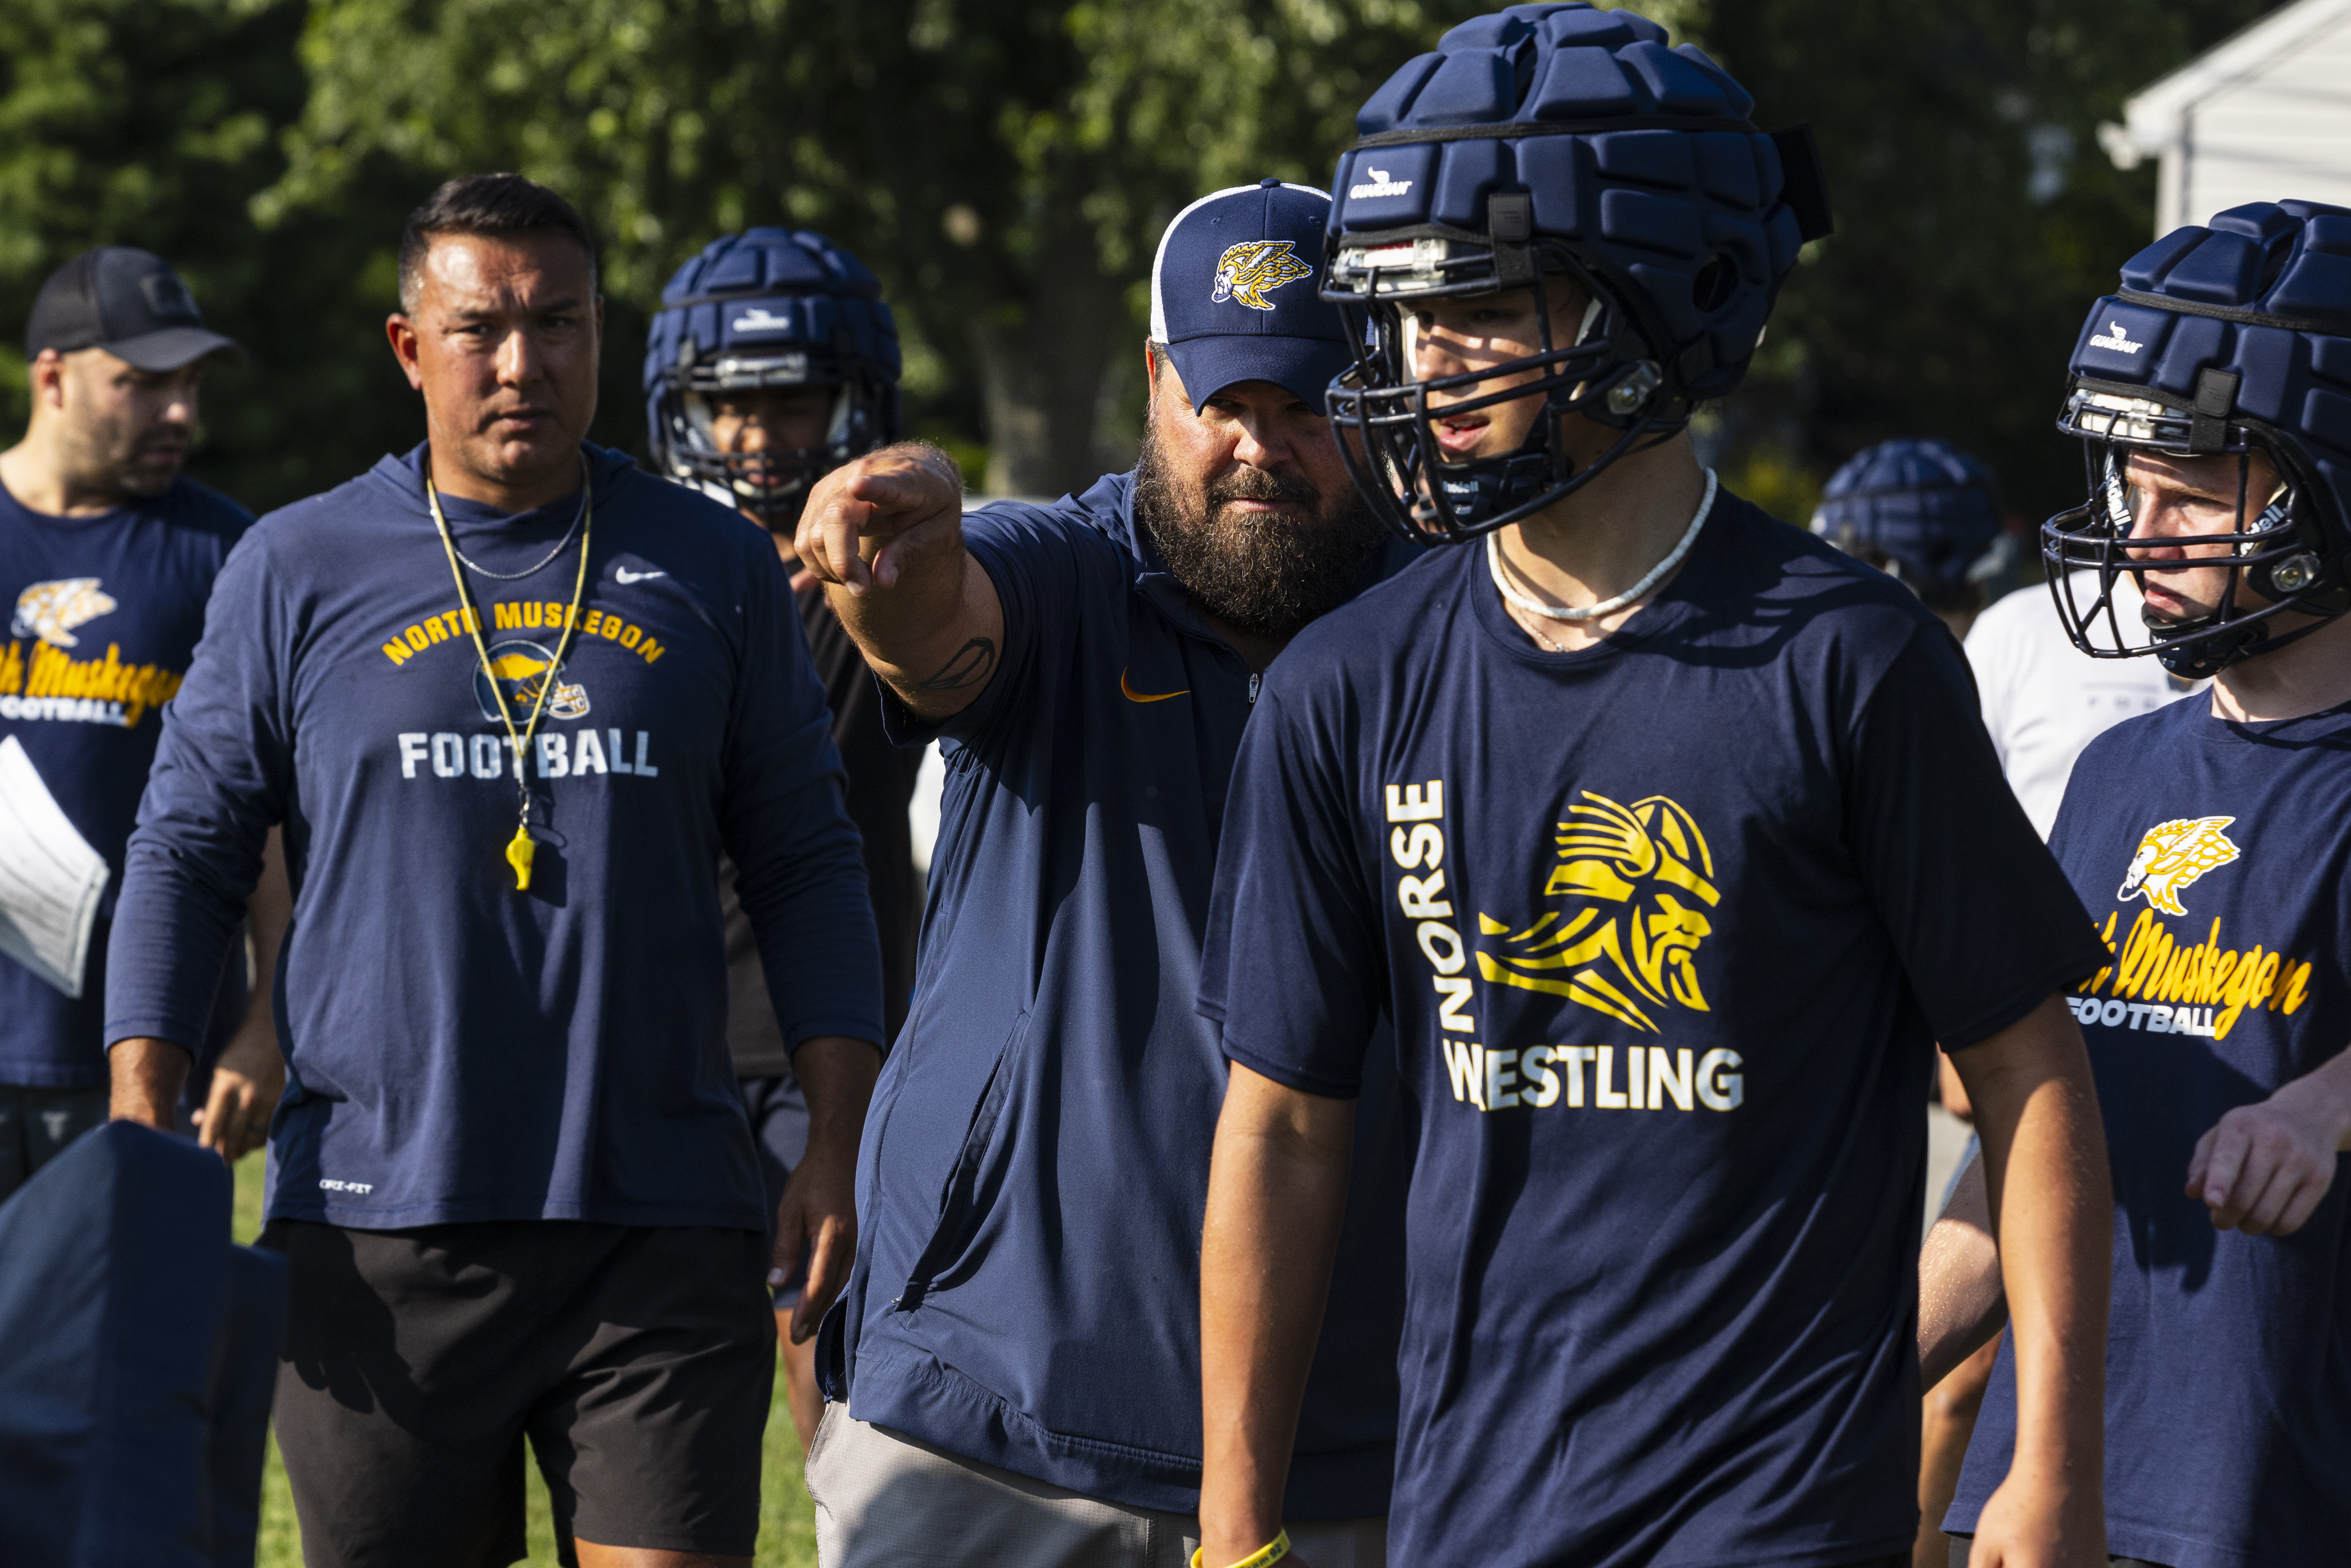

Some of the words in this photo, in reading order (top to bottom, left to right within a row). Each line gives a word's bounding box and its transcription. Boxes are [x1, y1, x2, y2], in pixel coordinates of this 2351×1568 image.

[381, 606, 483, 665] NORTH
[493, 601, 666, 664] MUSKEGON
[0, 694, 130, 727] OOTBALL
[398, 728, 658, 780] FOOTBALL
[1385, 780, 1475, 1034] NORSE
[2111, 907, 2313, 1041] Muskegon
[1442, 1038, 1744, 1112] WESTLING
